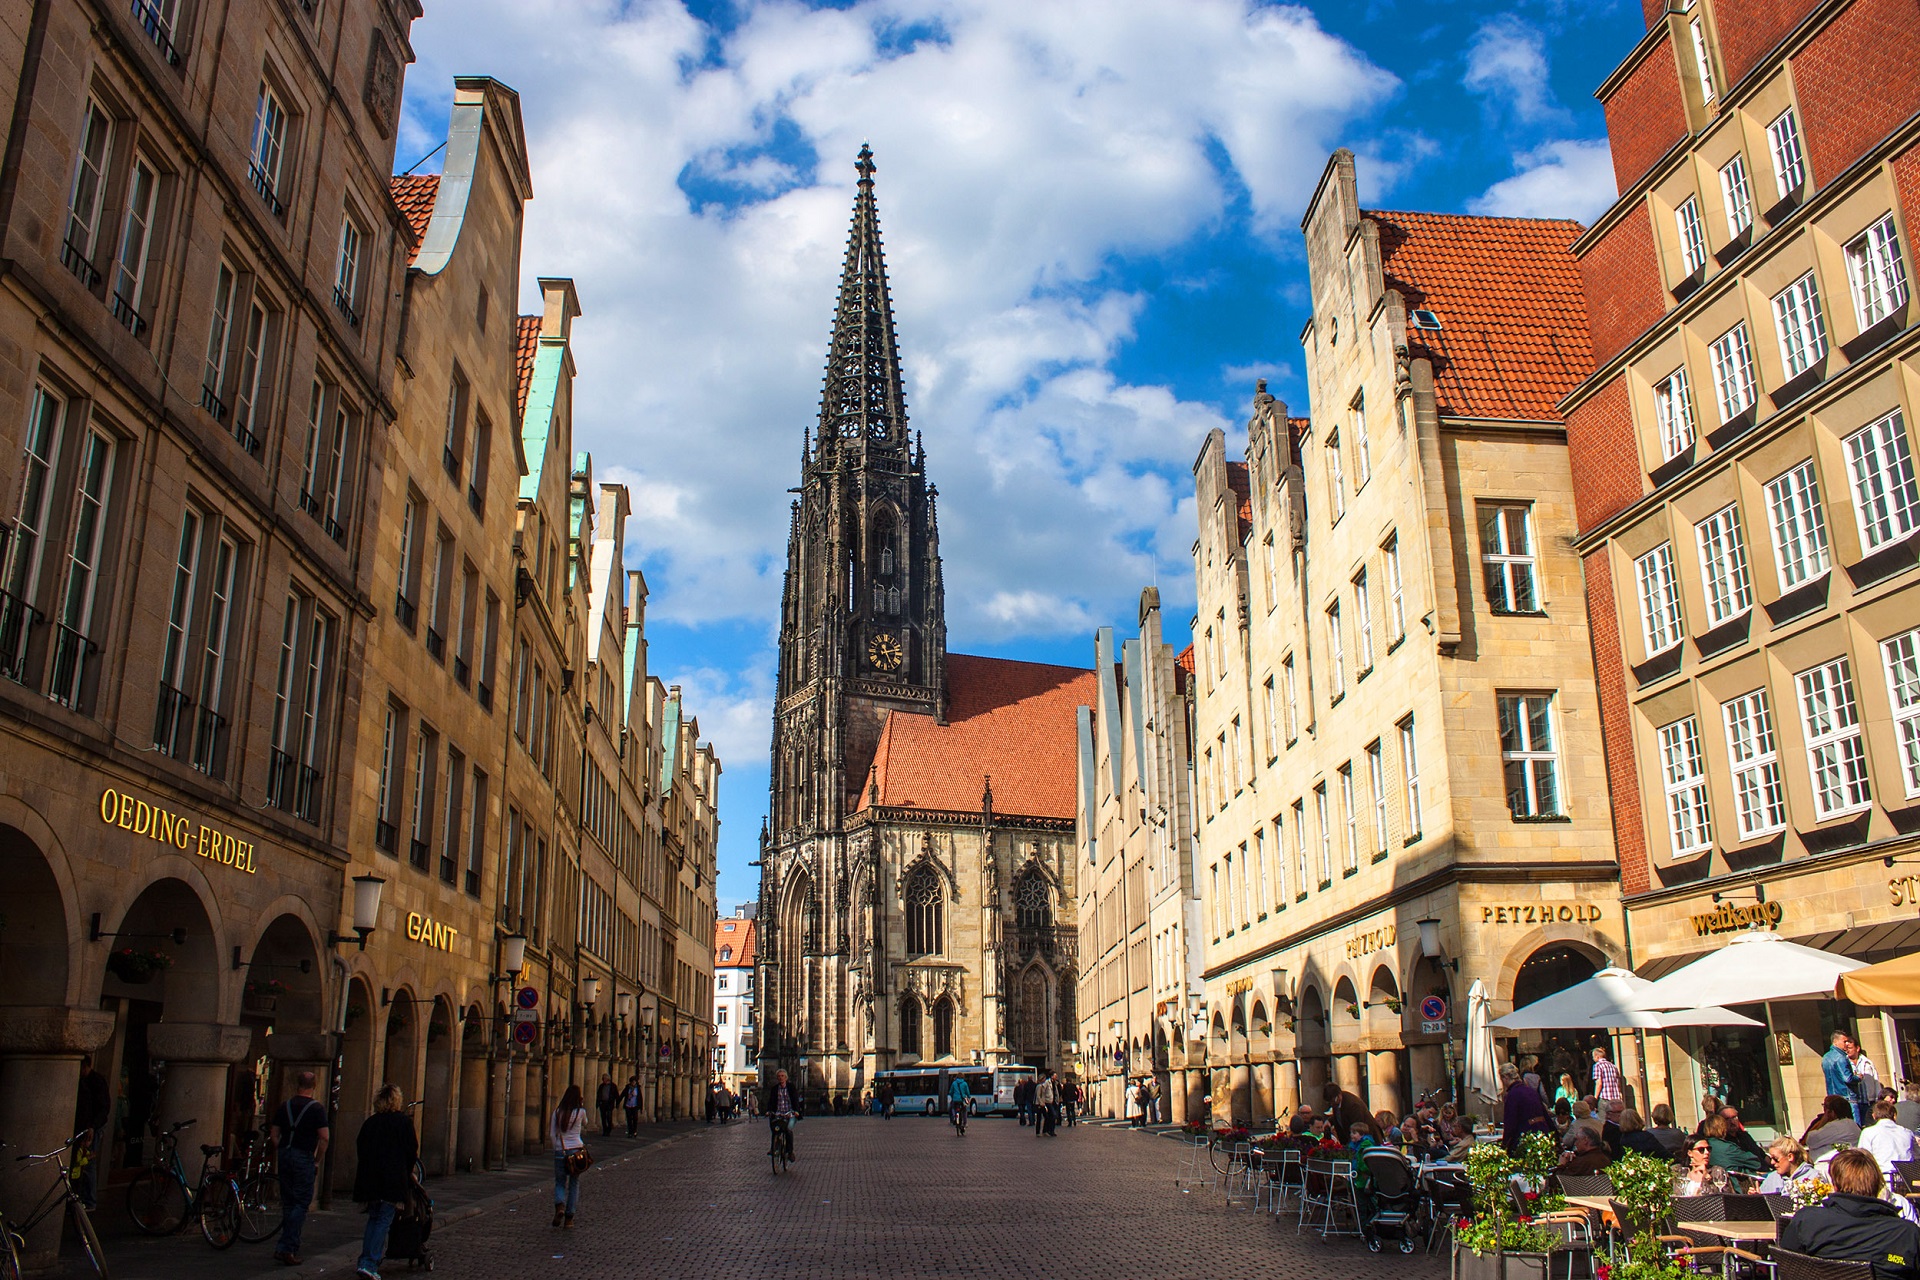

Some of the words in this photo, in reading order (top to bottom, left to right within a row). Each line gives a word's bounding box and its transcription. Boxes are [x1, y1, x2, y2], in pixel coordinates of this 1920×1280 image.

[101, 788, 257, 874] OEDING-ERDEL
[1888, 874, 1920, 906] ST
[1480, 905, 1602, 923] PETZHOLD
[1689, 900, 1782, 934] weitkamp
[406, 911, 458, 953] GANT
[1346, 924, 1397, 960] PETZHOLD
